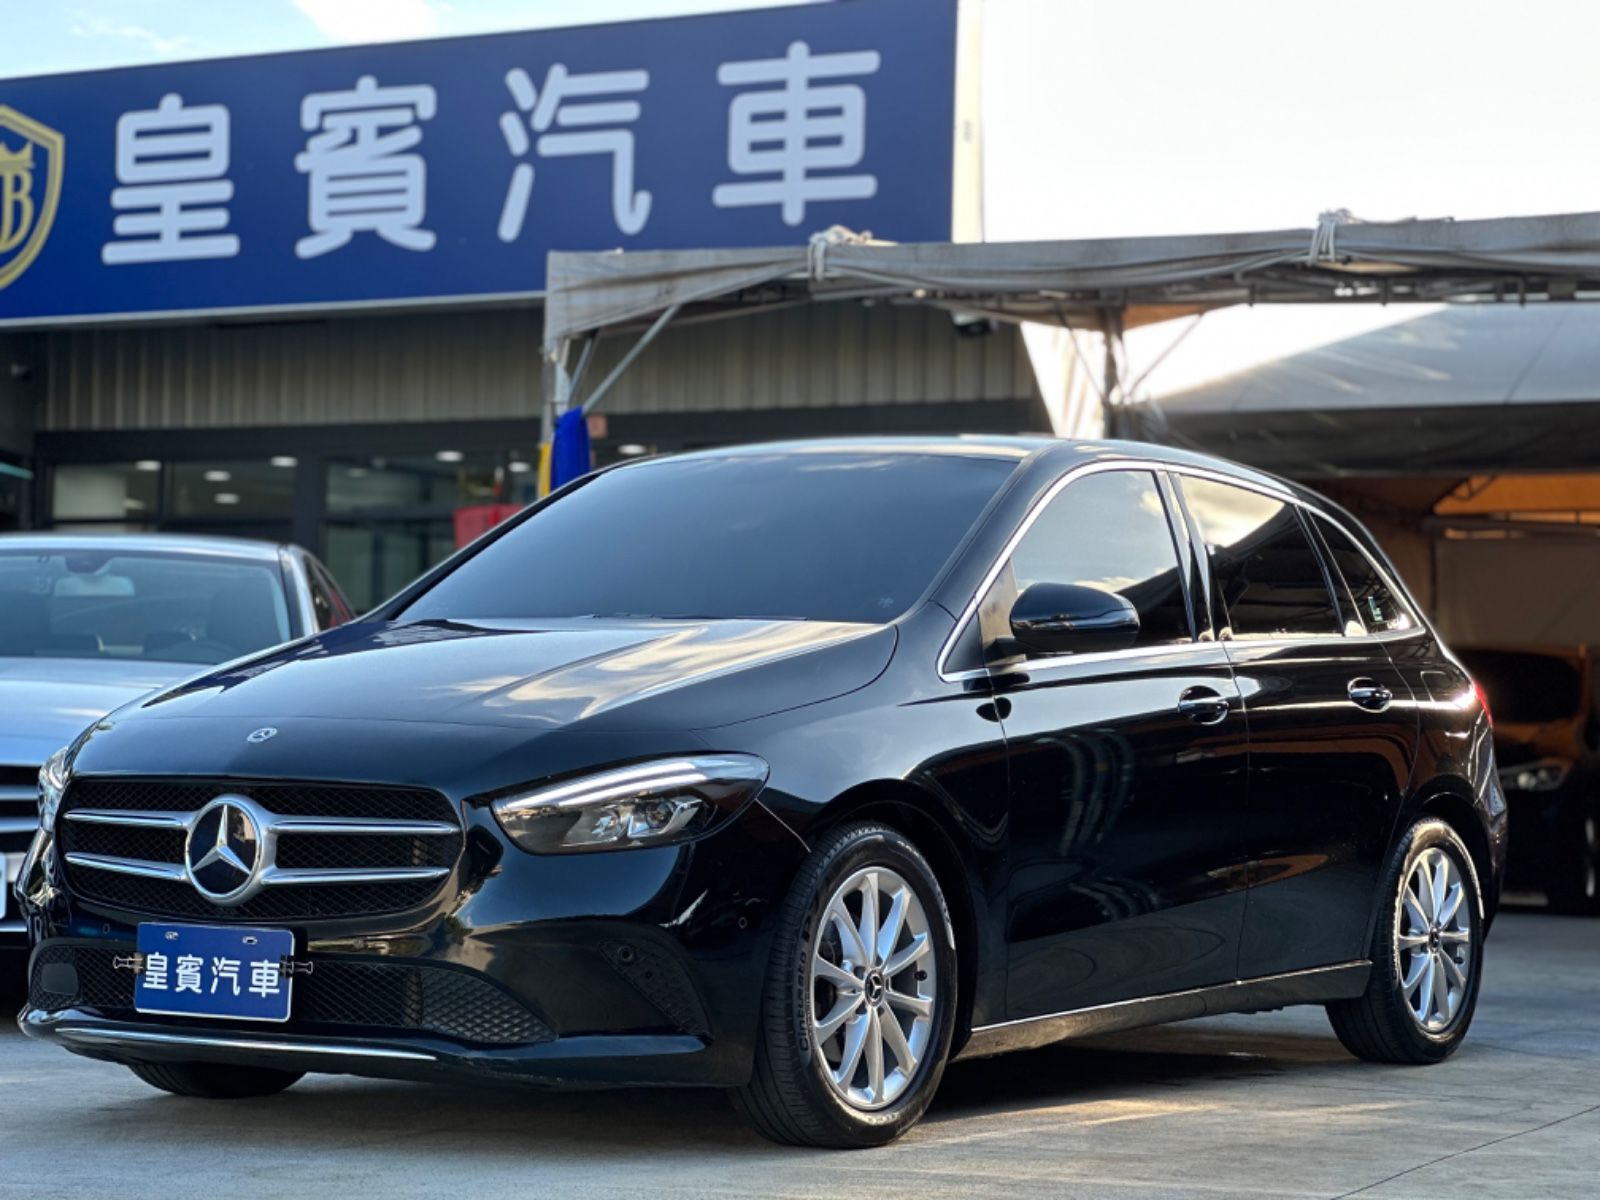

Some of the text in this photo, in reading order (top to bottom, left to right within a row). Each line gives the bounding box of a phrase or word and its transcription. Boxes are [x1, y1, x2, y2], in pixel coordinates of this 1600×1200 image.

[101, 40, 881, 265] 皇賓汽車
[142, 951, 281, 998] 皇賓汽車
